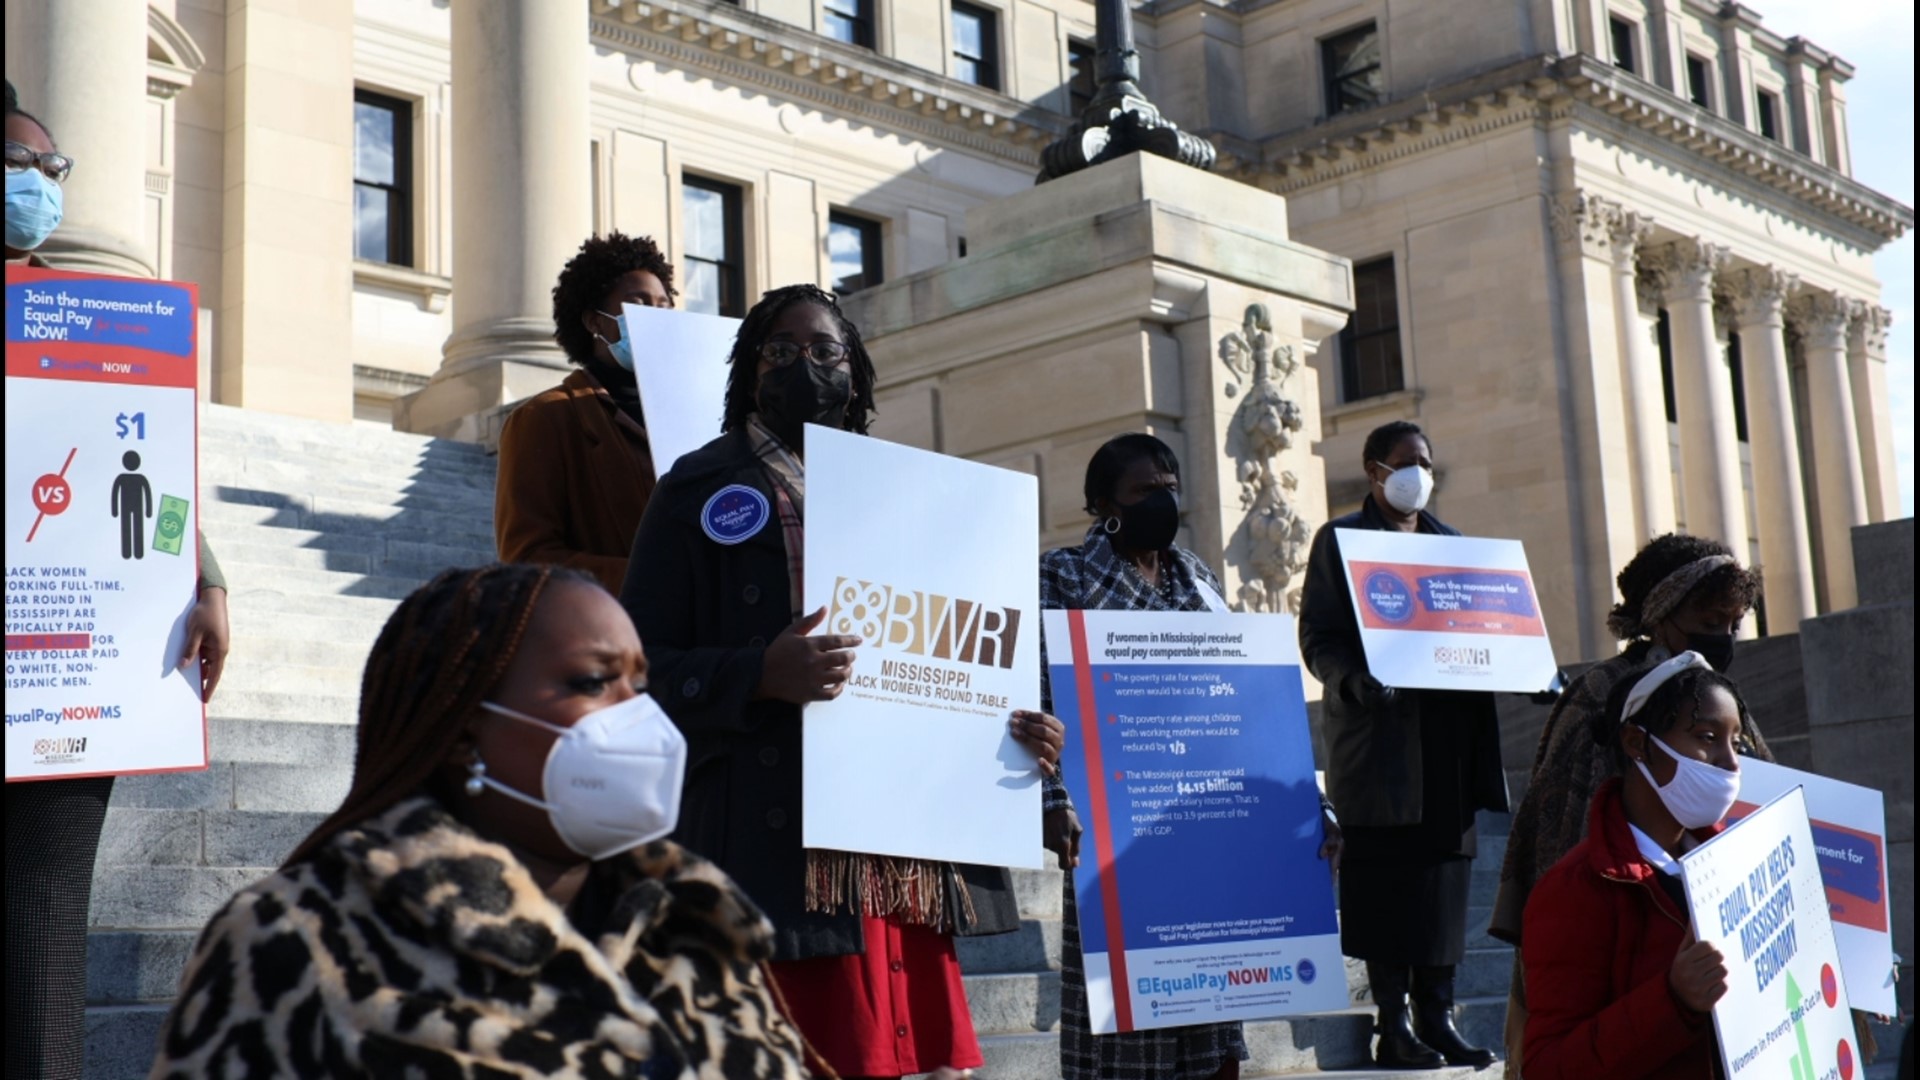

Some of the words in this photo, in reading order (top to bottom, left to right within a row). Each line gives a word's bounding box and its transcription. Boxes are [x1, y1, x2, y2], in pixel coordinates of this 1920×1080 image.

[24, 289, 54, 306] Join
[57, 292, 80, 308] the
[83, 298, 154, 315] movement
[155, 300, 175, 316] for
[24, 307, 63, 327] Equal
[66, 311, 93, 331] Pay
[24, 325, 68, 341] NOW!
[115, 412, 146, 440] $1
[38, 486, 65, 504] VS
[5, 567, 36, 577] LACK
[40, 567, 87, 577] WOMEN
[1428, 579, 1447, 590] Join
[1447, 579, 1462, 591] the
[1462, 583, 1506, 594] movement
[1505, 583, 1519, 594] for
[5, 595, 28, 604] EAR
[33, 595, 75, 604] ROUND
[79, 595, 92, 604] IN
[1430, 590, 1455, 602] Equal
[1455, 591, 1472, 604] Pay
[74, 608, 96, 618] ARE
[5, 622, 62, 633] YPICALLY
[67, 622, 95, 632] PAID
[882, 586, 1011, 668] BWR
[92, 635, 115, 645] FOR
[1107, 631, 1115, 645] If
[1115, 634, 1149, 643] women
[1149, 631, 1159, 643] in
[1160, 631, 1206, 646] Mississippi
[1207, 632, 1243, 643] received
[5, 651, 36, 660] VERY
[42, 650, 88, 660] DOLLAR
[92, 648, 119, 658] PAID
[1104, 646, 1131, 660] equal
[1131, 648, 1148, 660] pay
[1149, 646, 1200, 660] comparable
[1201, 646, 1221, 658] with
[6, 664, 15, 674] O
[20, 663, 62, 675] WHITE,
[66, 663, 98, 673] NON-
[881, 659, 971, 689] MISSISSIPPI
[62, 676, 92, 687] MEN.
[1113, 672, 1129, 682] The
[1130, 674, 1160, 684] poverty
[1161, 674, 1177, 682] rate
[1178, 672, 1190, 682] for
[1190, 673, 1221, 684] working
[848, 674, 877, 690] LACK
[881, 678, 932, 698] WOMEN'S
[934, 687, 973, 704] ROUND
[976, 692, 1009, 710] TABLE
[1115, 688, 1145, 696] women
[1146, 687, 1170, 696] would
[1171, 687, 1181, 695] be
[1183, 687, 1195, 695] cut
[1196, 686, 1206, 698] by
[5, 705, 122, 727] qualPayNOWMS
[1118, 714, 1134, 724] The
[1136, 715, 1165, 726] poverty
[1166, 715, 1183, 724] rate
[1184, 715, 1211, 725] among
[1211, 713, 1242, 722] children
[1121, 728, 1139, 737] with
[1139, 728, 1171, 739] working
[1171, 728, 1204, 737] mothers
[1205, 727, 1228, 736] would
[1229, 727, 1240, 736] be
[1122, 742, 1155, 752] reduced
[1156, 742, 1166, 754] by
[1126, 770, 1141, 780] The
[1142, 769, 1184, 781] Mississippi
[1185, 769, 1221, 780] economy
[1222, 767, 1245, 777] would
[1127, 784, 1147, 795] have
[1149, 782, 1174, 793] added
[1177, 780, 1206, 795] $4.15
[1205, 777, 1244, 792] billion
[1163, 797, 1179, 806] and
[1234, 794, 1252, 804] That
[1131, 811, 1173, 824] equivalent
[1174, 811, 1183, 820] to
[1184, 810, 1196, 821] 3.9
[1196, 810, 1227, 822] percent
[1227, 808, 1236, 819] of
[1236, 808, 1250, 818] the
[1847, 848, 1865, 865] for
[1718, 881, 1752, 939] EQUAL
[1748, 860, 1769, 908] PAY
[1766, 833, 1796, 888] HELPS
[1739, 878, 1796, 963] MISSISSIPPI
[1754, 918, 1798, 993] ECONOMY
[1731, 1045, 1759, 1074] Women
[1758, 1038, 1767, 1052] in
[1765, 1017, 1792, 1046] Poverty
[1804, 995, 1816, 1012] Cut
